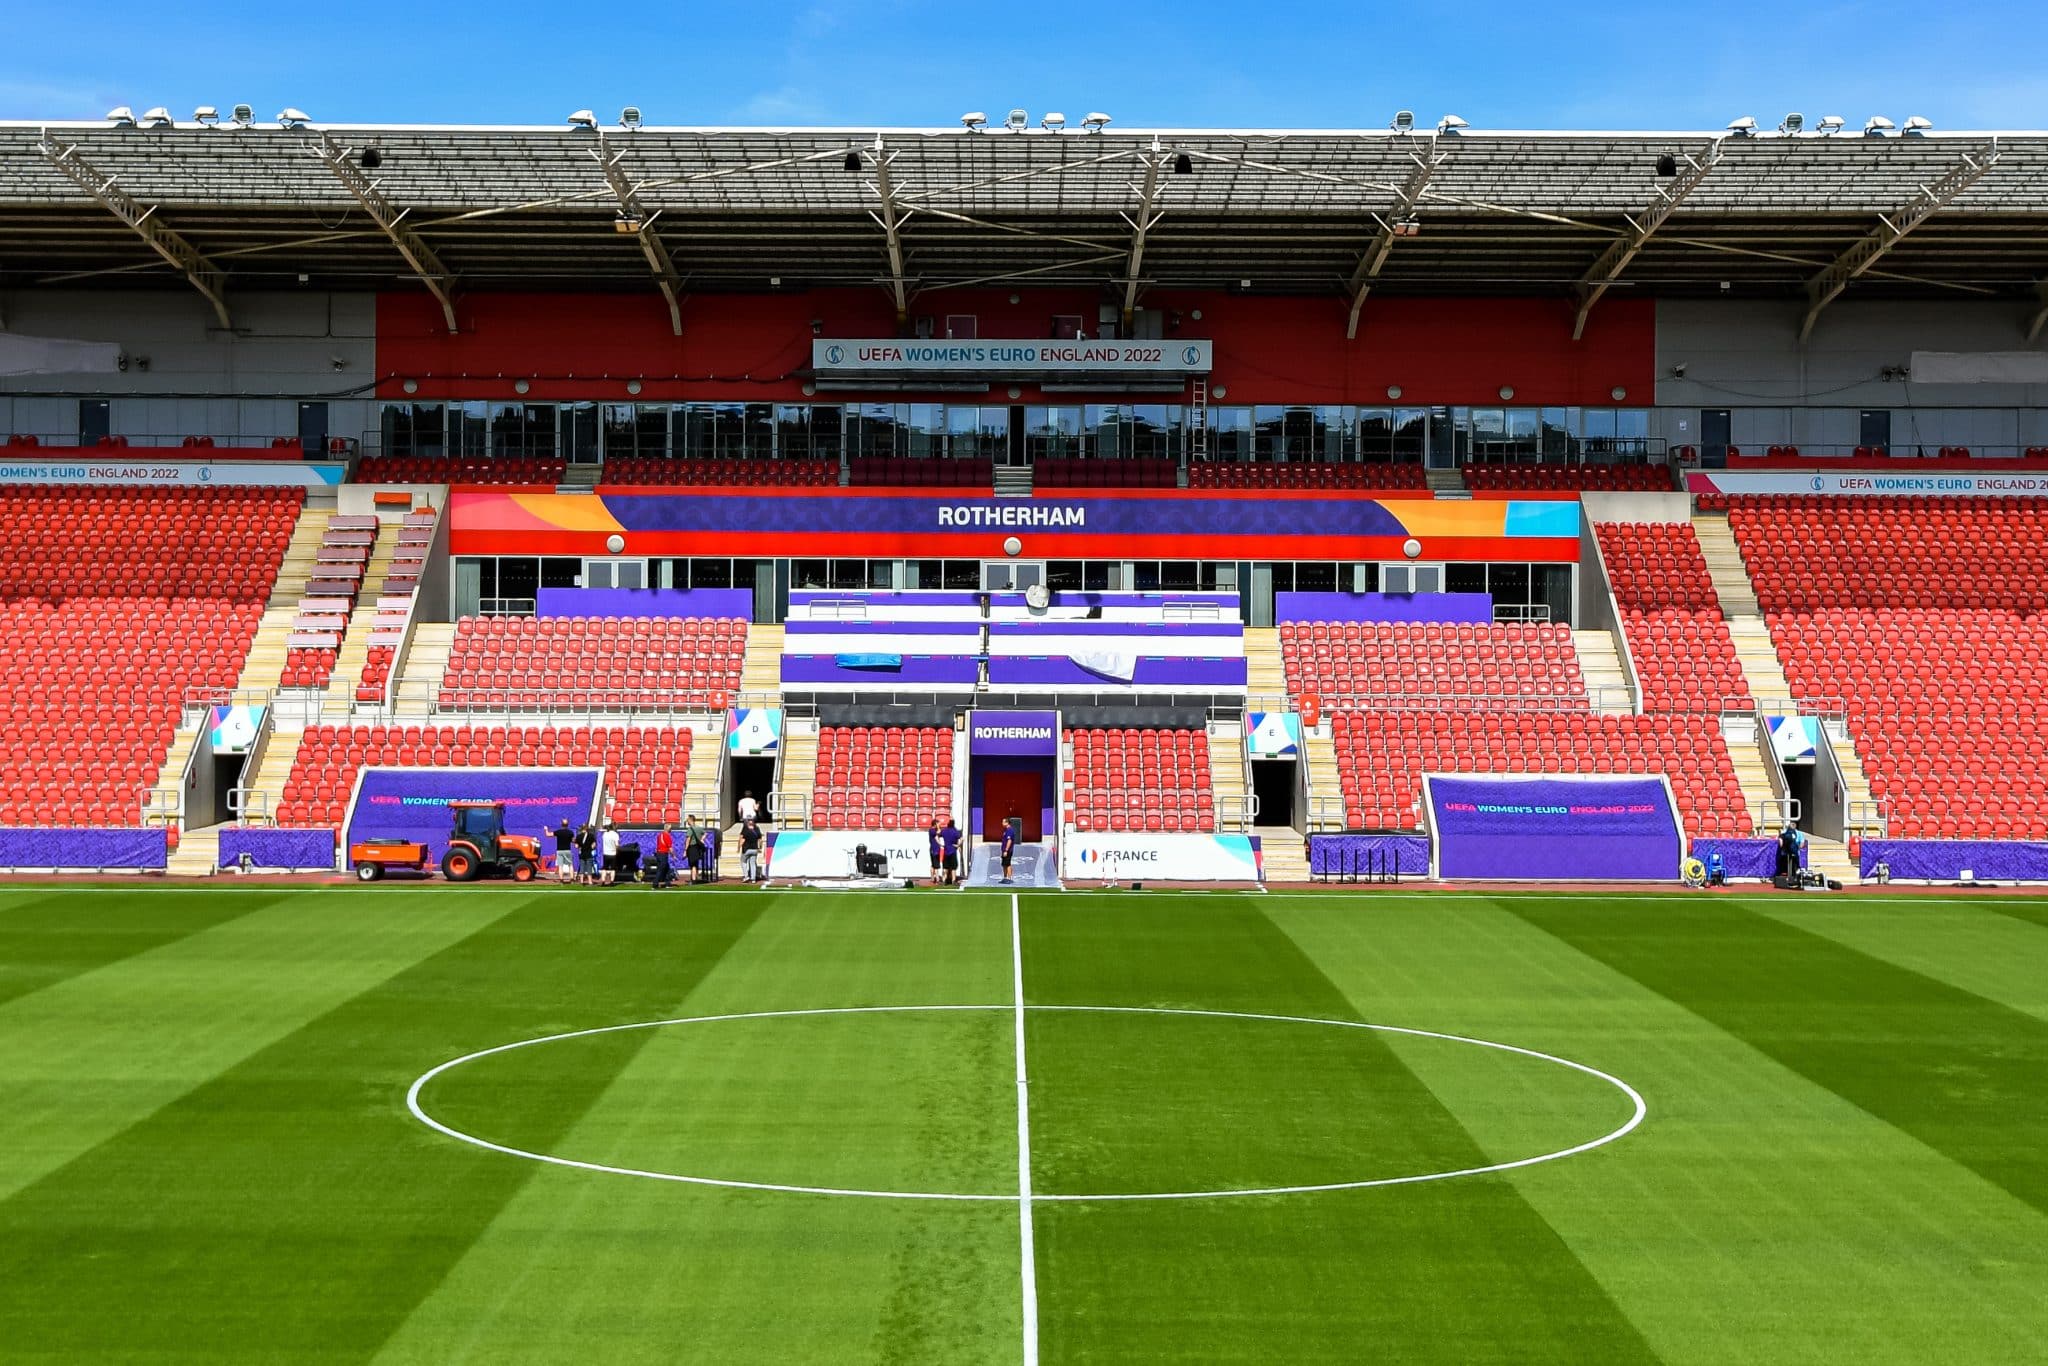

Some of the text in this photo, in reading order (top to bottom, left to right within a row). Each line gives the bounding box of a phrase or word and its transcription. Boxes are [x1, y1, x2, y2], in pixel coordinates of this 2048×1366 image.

[859, 348, 1161, 362] UEFA WOMEN'S EURO ENGLAND 2022
[0, 467, 179, 479] OMEN'S EURO ENGLAND 2022
[1839, 478, 1872, 489] UEFA
[1874, 479, 1934, 489] WOMEN'S
[1937, 479, 1972, 489] EURO
[1977, 479, 2036, 490] ENGLAND
[938, 506, 1085, 526] ROTHERHAM
[752, 725, 759, 733] D
[974, 727, 1051, 739] ROTHERHAM
[1269, 729, 1275, 737] E
[1445, 802, 1476, 812] UEFA
[1477, 804, 1533, 814] WOMEN'S
[1535, 806, 1568, 814] EURO
[1569, 805, 1626, 814] ENGLAND
[883, 848, 921, 860] ITALY
[1105, 850, 1158, 861] FRANCE
